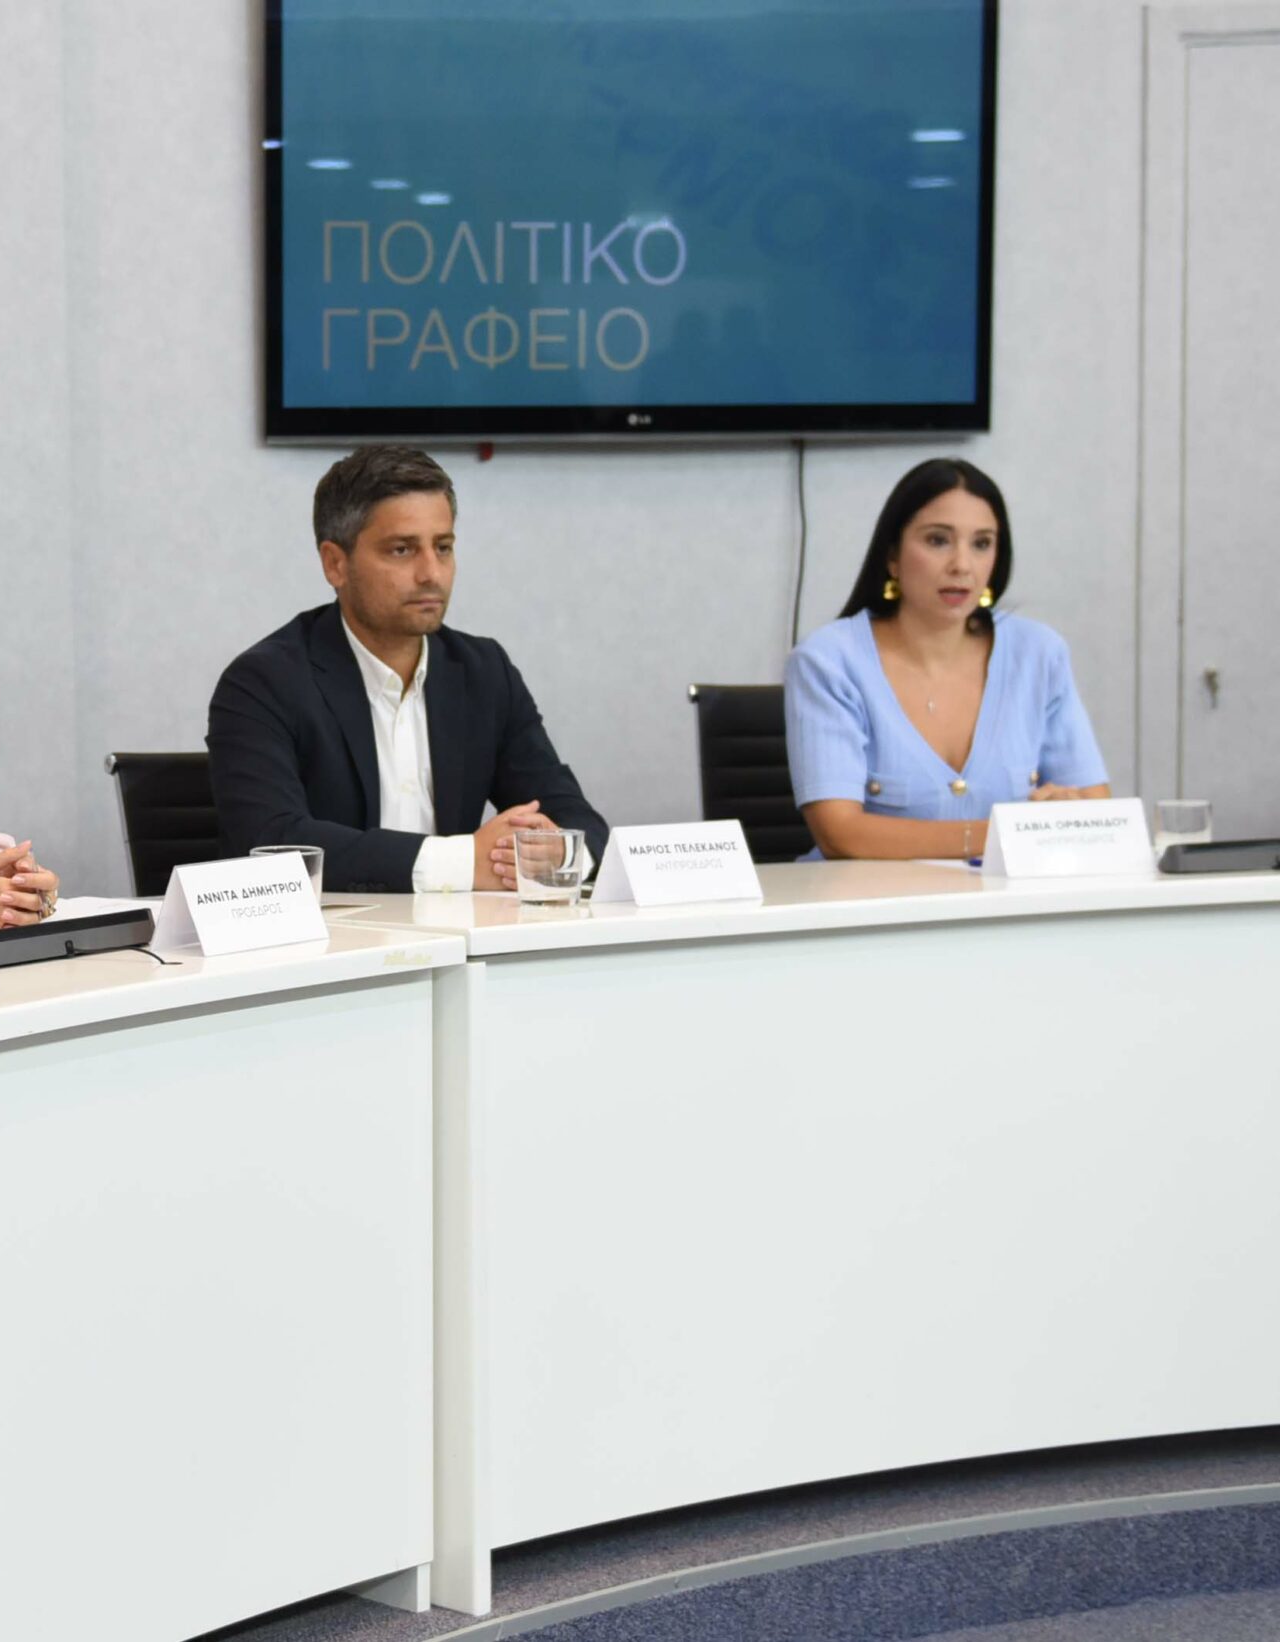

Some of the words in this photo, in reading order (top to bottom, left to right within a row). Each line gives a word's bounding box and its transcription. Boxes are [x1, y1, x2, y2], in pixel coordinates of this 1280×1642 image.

[322, 220, 688, 286] ΠΟΛΙΤΙΚΟ
[322, 306, 651, 372] ΓΡΑΦΕΙΟ
[629, 844, 672, 855] ΜΑΡΙΟΣ
[675, 841, 738, 853] ΠΕΛΕΚΑΝΟΣ
[197, 889, 238, 905] ΑΝΝΙΤΑ
[242, 881, 303, 899] ΔΗΜΗΤΡΙΟΥ
[231, 902, 283, 919] ΠΡΟΕΔΡΟΣ
